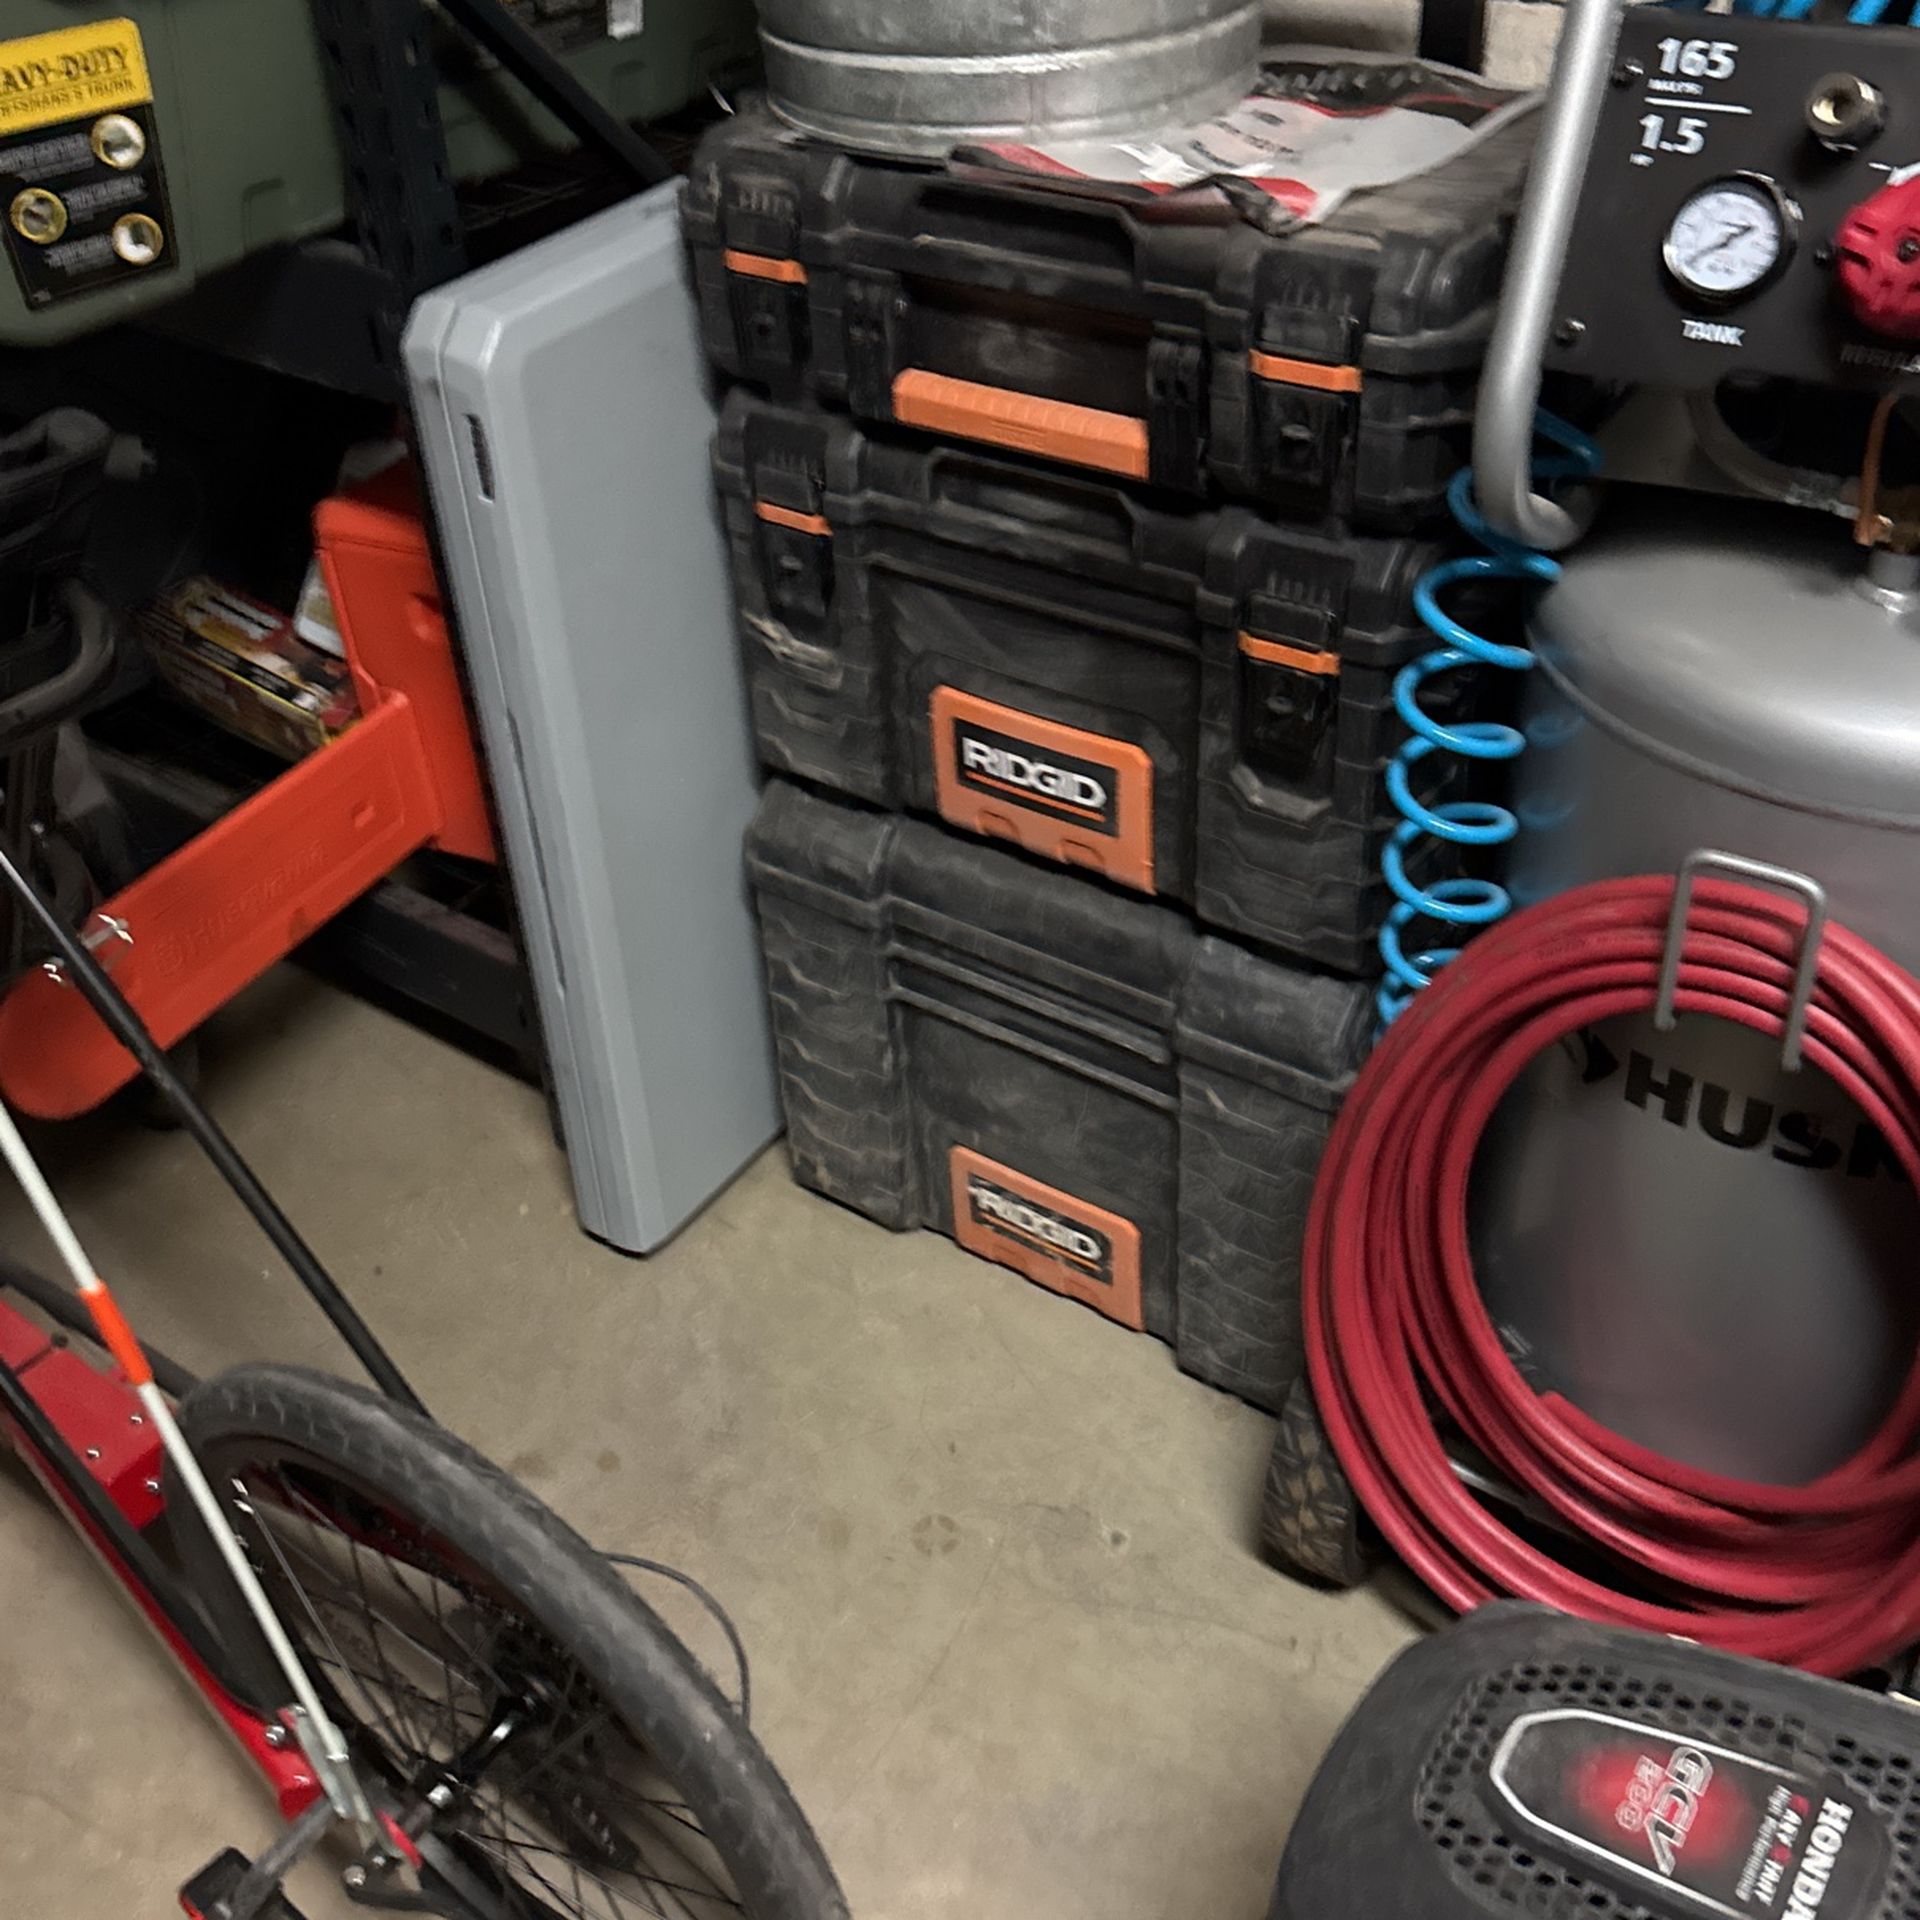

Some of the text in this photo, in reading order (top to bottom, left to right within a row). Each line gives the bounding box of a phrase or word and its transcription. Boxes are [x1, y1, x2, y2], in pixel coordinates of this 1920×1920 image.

[1656, 36, 1740, 80] 165
[1638, 113, 1708, 155] 1.5
[1681, 319, 1746, 347] TANK
[962, 736, 1107, 810] RIDGID
[968, 1186, 1103, 1261] RIDGID
[1643, 1746, 1714, 1877] GCV
[1781, 1797, 1855, 1920] HONDA
